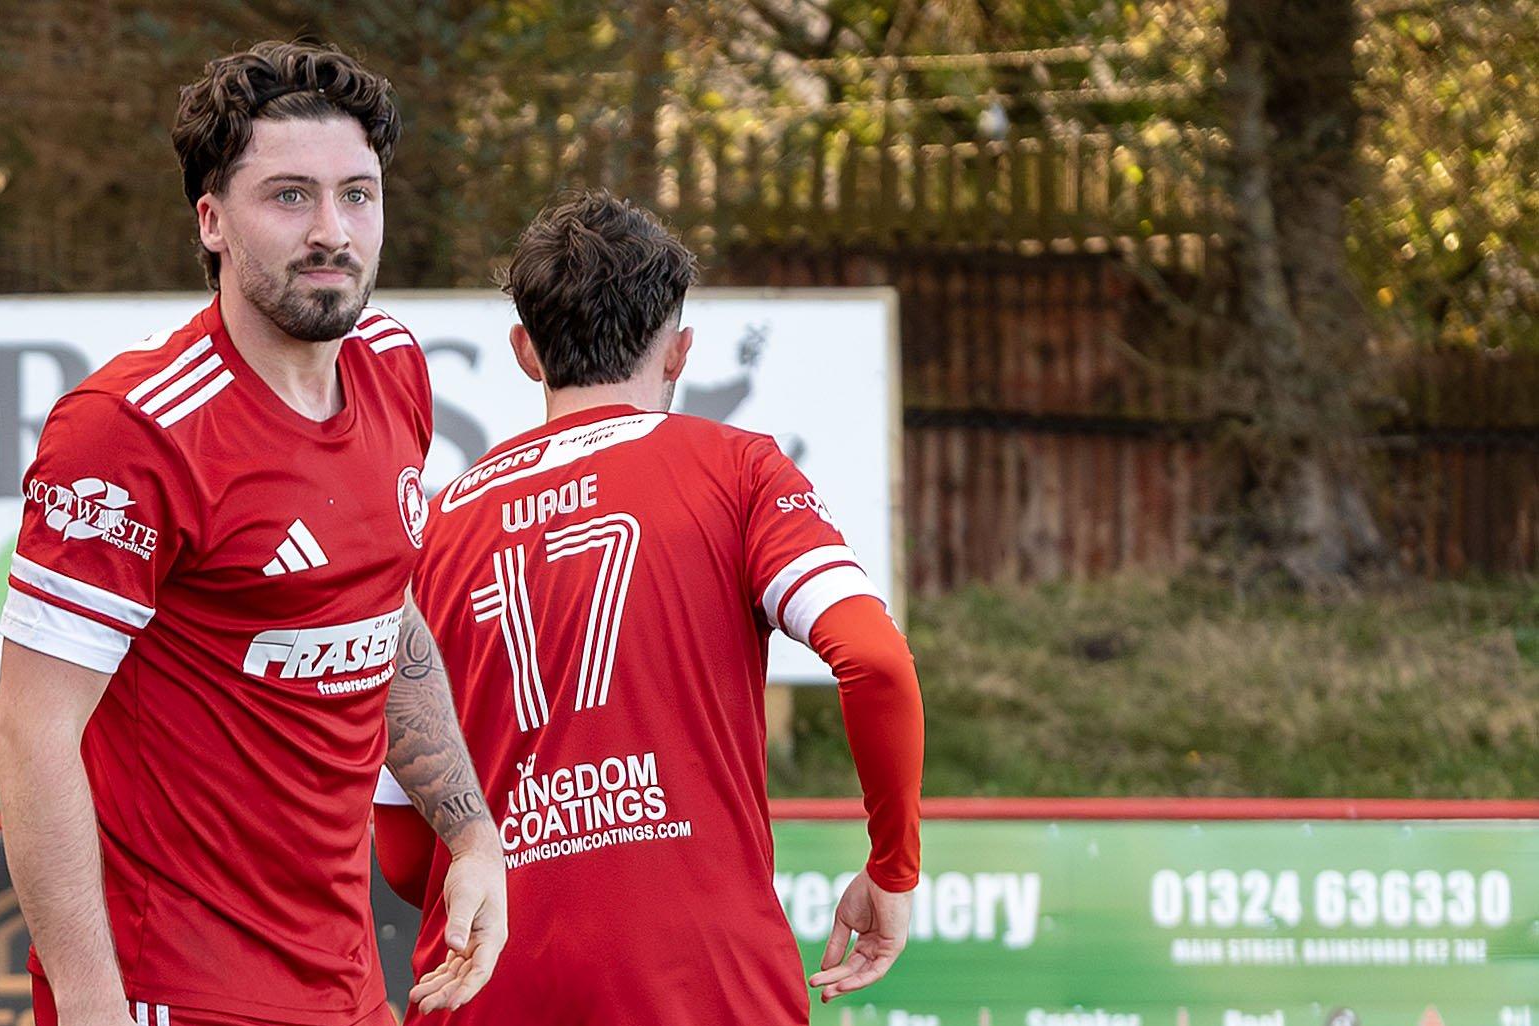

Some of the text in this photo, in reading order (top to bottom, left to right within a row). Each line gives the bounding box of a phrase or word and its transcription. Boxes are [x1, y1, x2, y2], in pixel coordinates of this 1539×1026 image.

[457, 447, 541, 495] Moore
[26, 478, 159, 552] SCOTWASTE
[501, 473, 598, 533] WADE
[101, 533, 151, 560] Recycling
[471, 513, 641, 732] 17
[499, 786, 667, 850] COATINGS
[1151, 869, 1511, 928] 01324 636330
